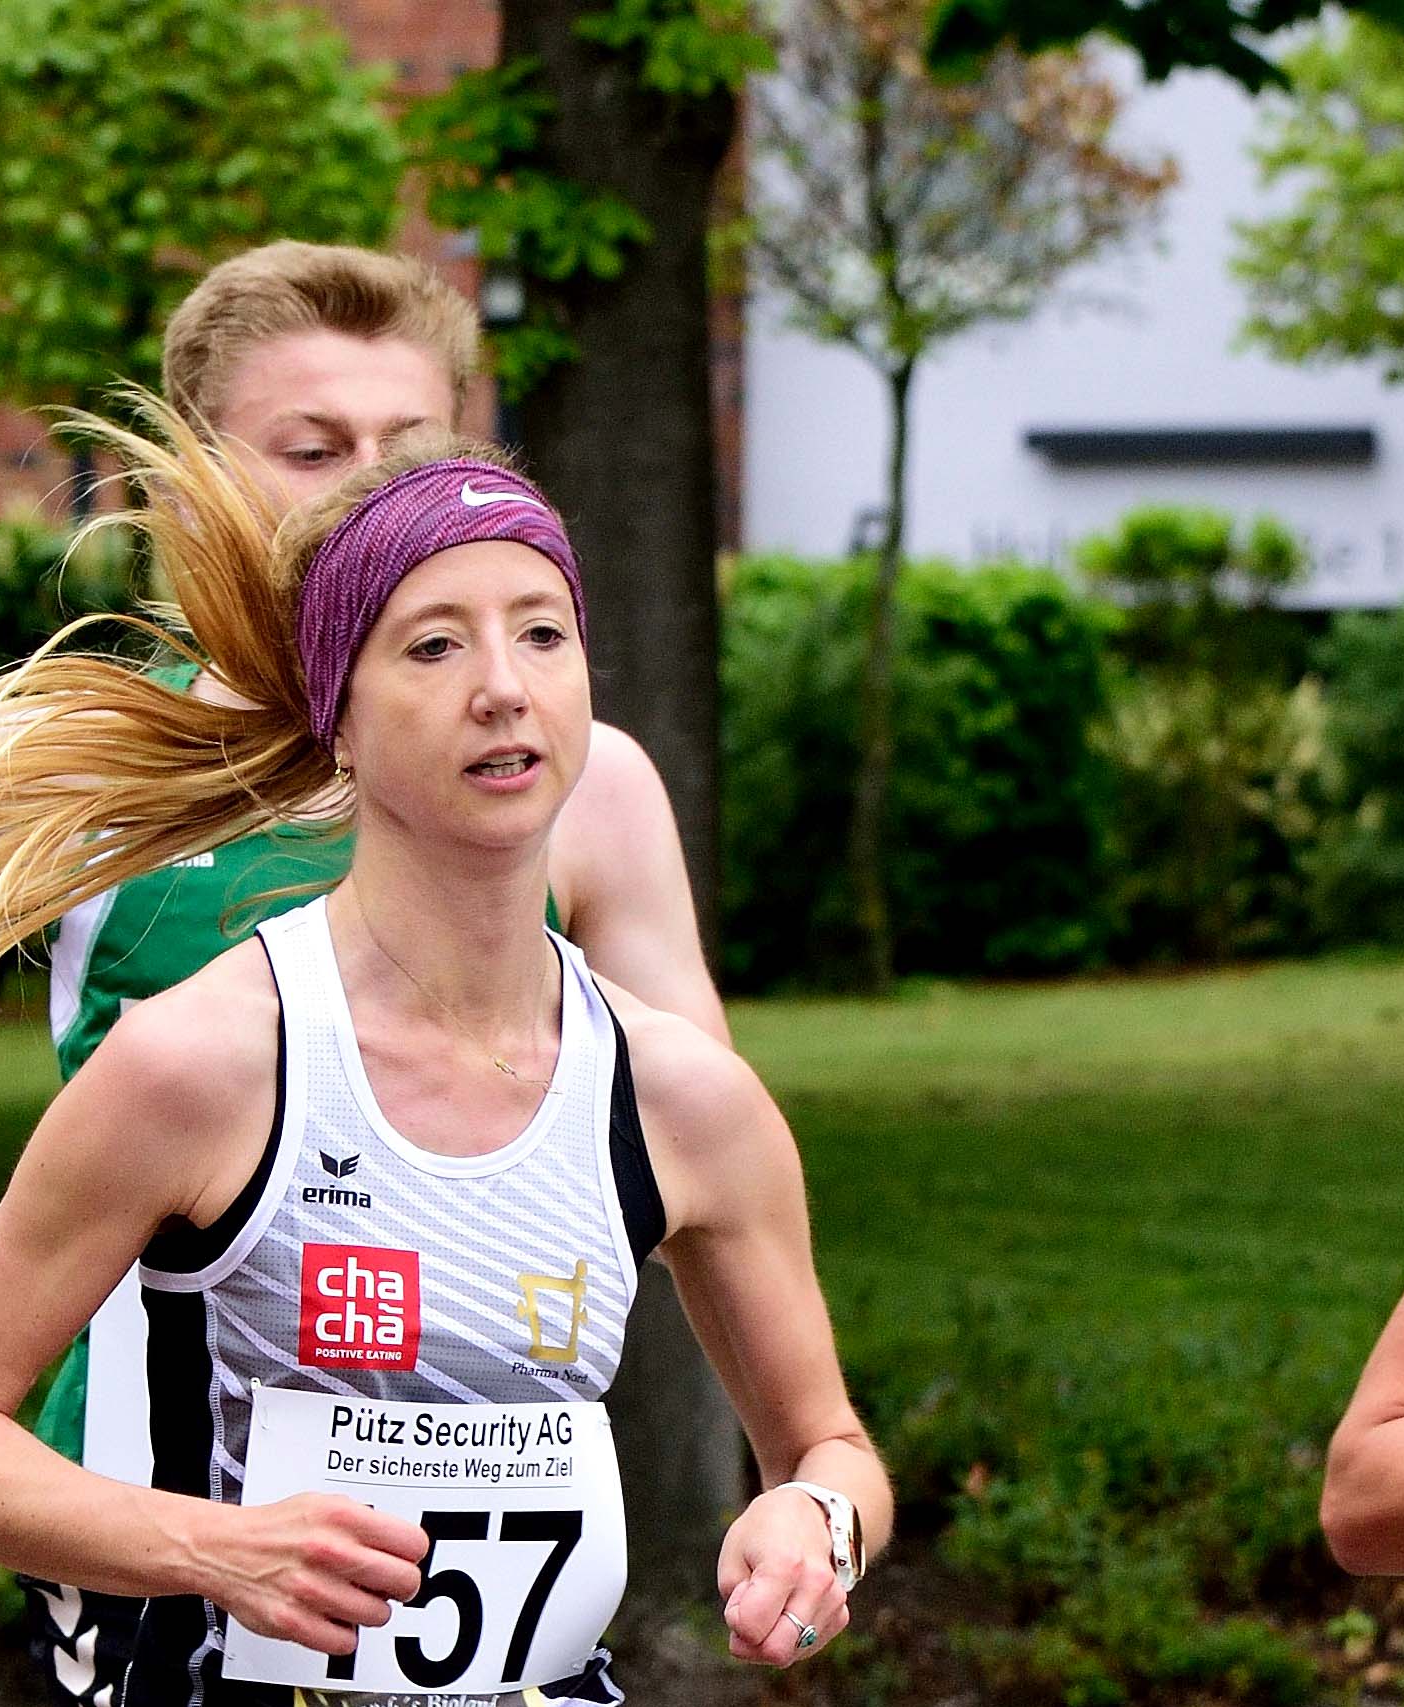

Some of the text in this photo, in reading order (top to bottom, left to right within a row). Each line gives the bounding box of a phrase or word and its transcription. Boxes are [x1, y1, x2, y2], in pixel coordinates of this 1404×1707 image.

[302, 1185, 371, 1208] erima
[316, 1256, 405, 1300] cha
[315, 1348, 402, 1361] POSITIVE EATING
[511, 1362, 588, 1384] Pharma Nord
[331, 1405, 573, 1455] Pütz Security AG
[327, 1450, 573, 1483] Der sicherste Weg zum Ziel
[325, 1504, 584, 1688] 57
